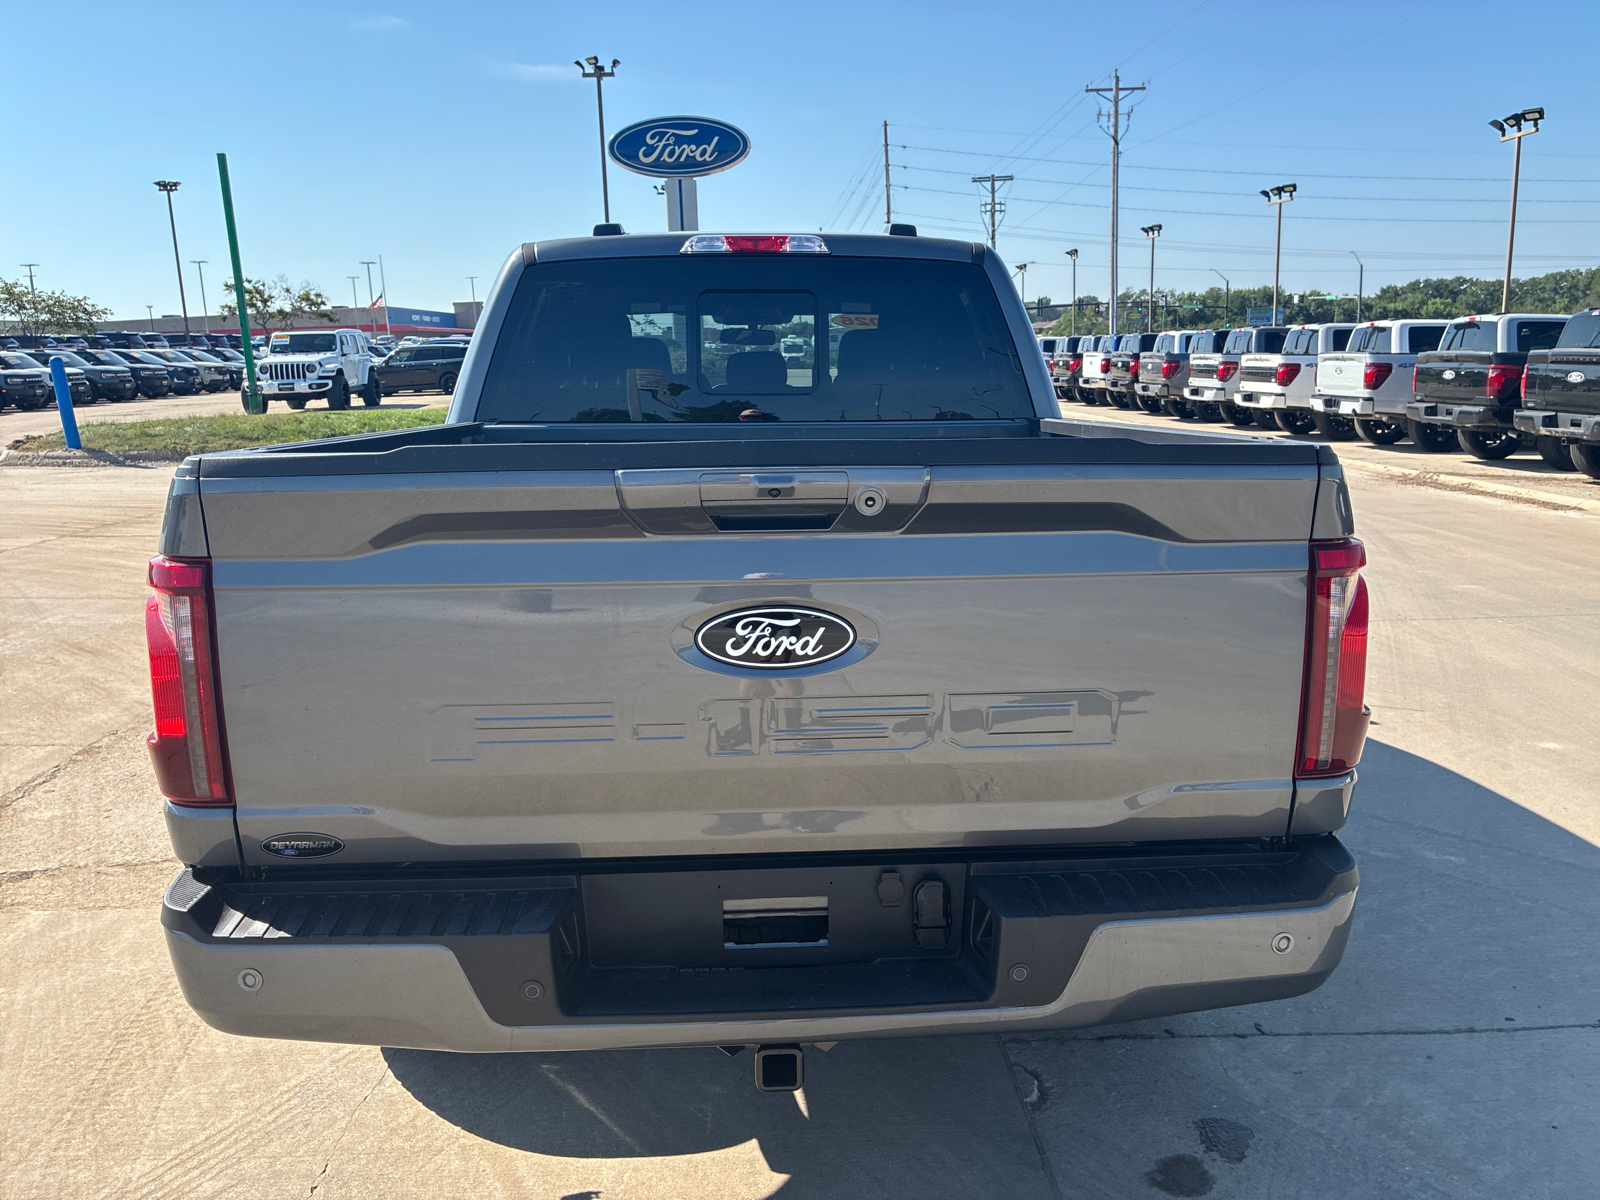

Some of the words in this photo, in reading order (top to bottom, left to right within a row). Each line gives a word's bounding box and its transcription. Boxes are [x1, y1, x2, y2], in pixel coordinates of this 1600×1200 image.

[638, 128, 720, 163] Ford
[725, 616, 826, 657] Ford
[270, 841, 335, 850] DEYARMAN
